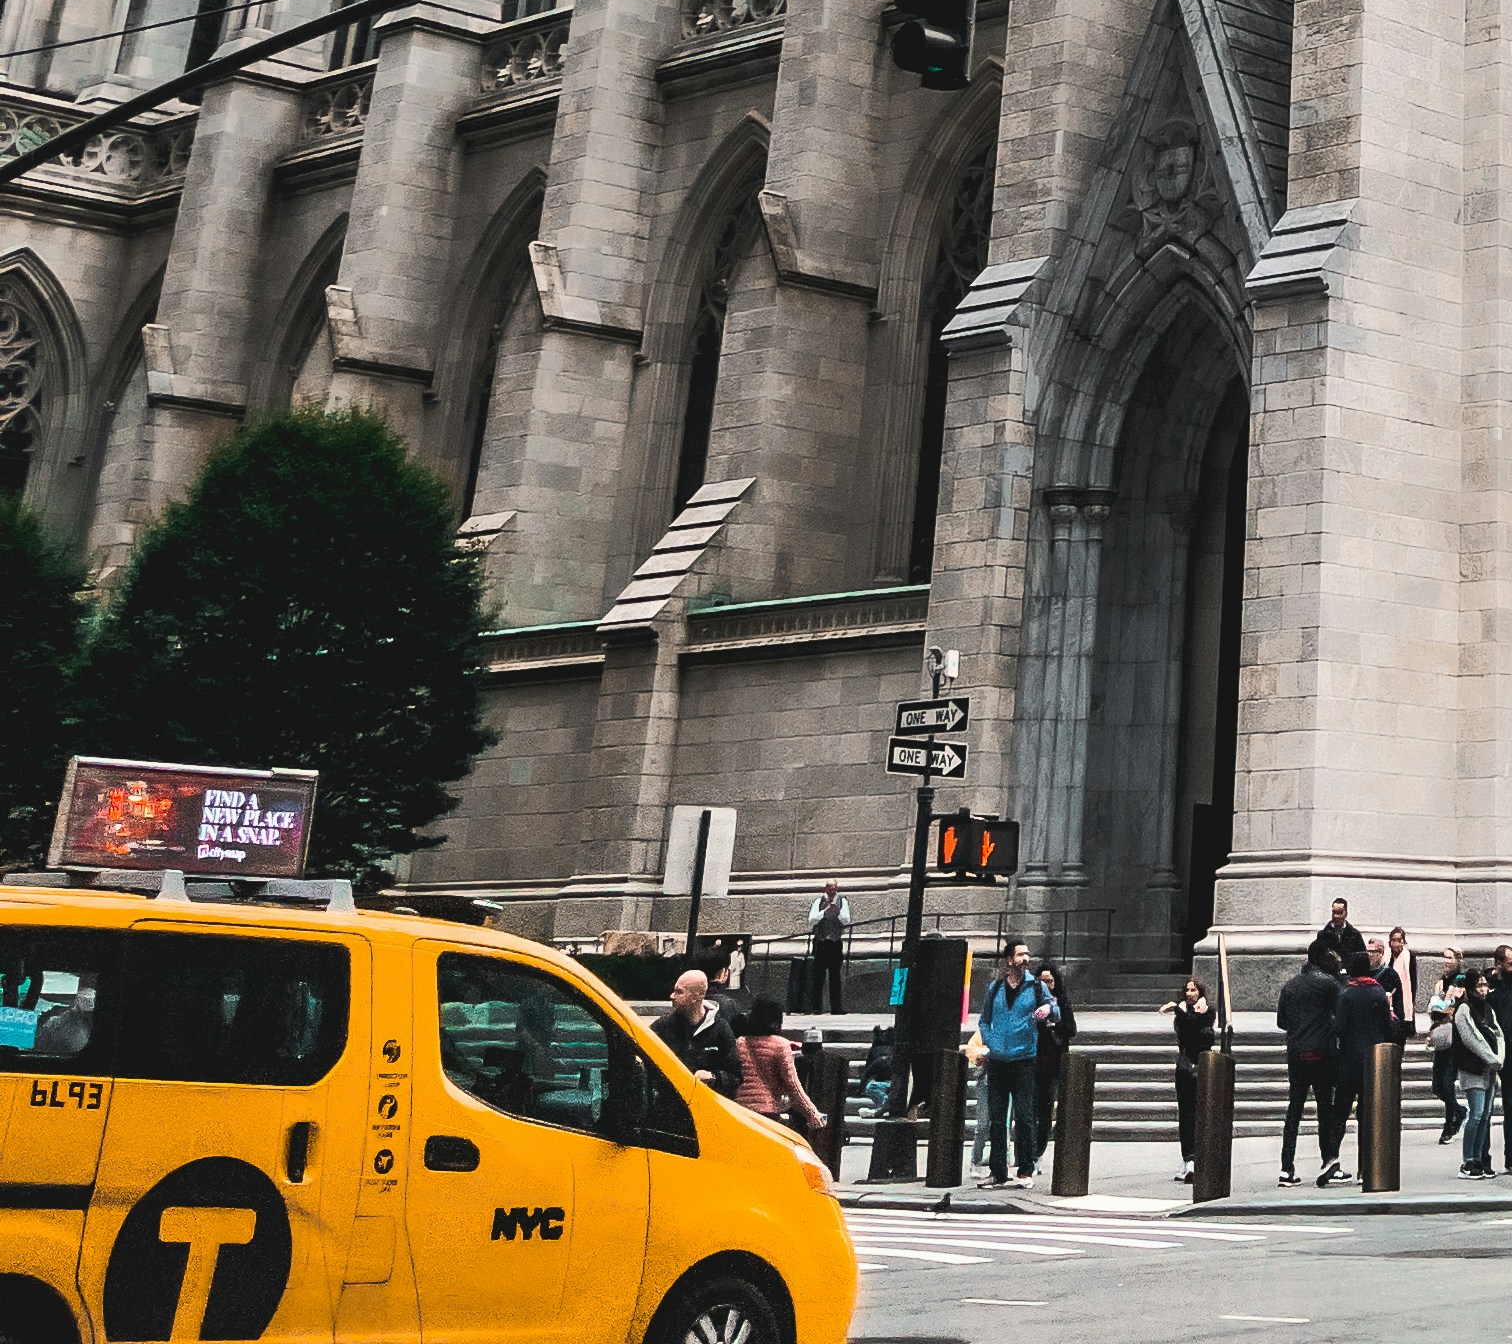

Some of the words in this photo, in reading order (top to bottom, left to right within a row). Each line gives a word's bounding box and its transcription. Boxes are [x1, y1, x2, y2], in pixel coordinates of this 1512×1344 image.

[906, 711, 927, 726] ONE
[935, 708, 958, 723] WAY
[899, 749, 922, 765] ONE
[931, 753, 955, 768] WAY
[204, 789, 246, 808] FIND
[248, 793, 259, 810] A
[202, 806, 242, 825] NEW
[243, 810, 295, 829] PLACE
[198, 824, 219, 842] IN
[219, 825, 234, 843] A
[237, 827, 283, 846] SNAP.
[30, 1079, 104, 1110] 6L93
[490, 1206, 566, 1241] NYC
